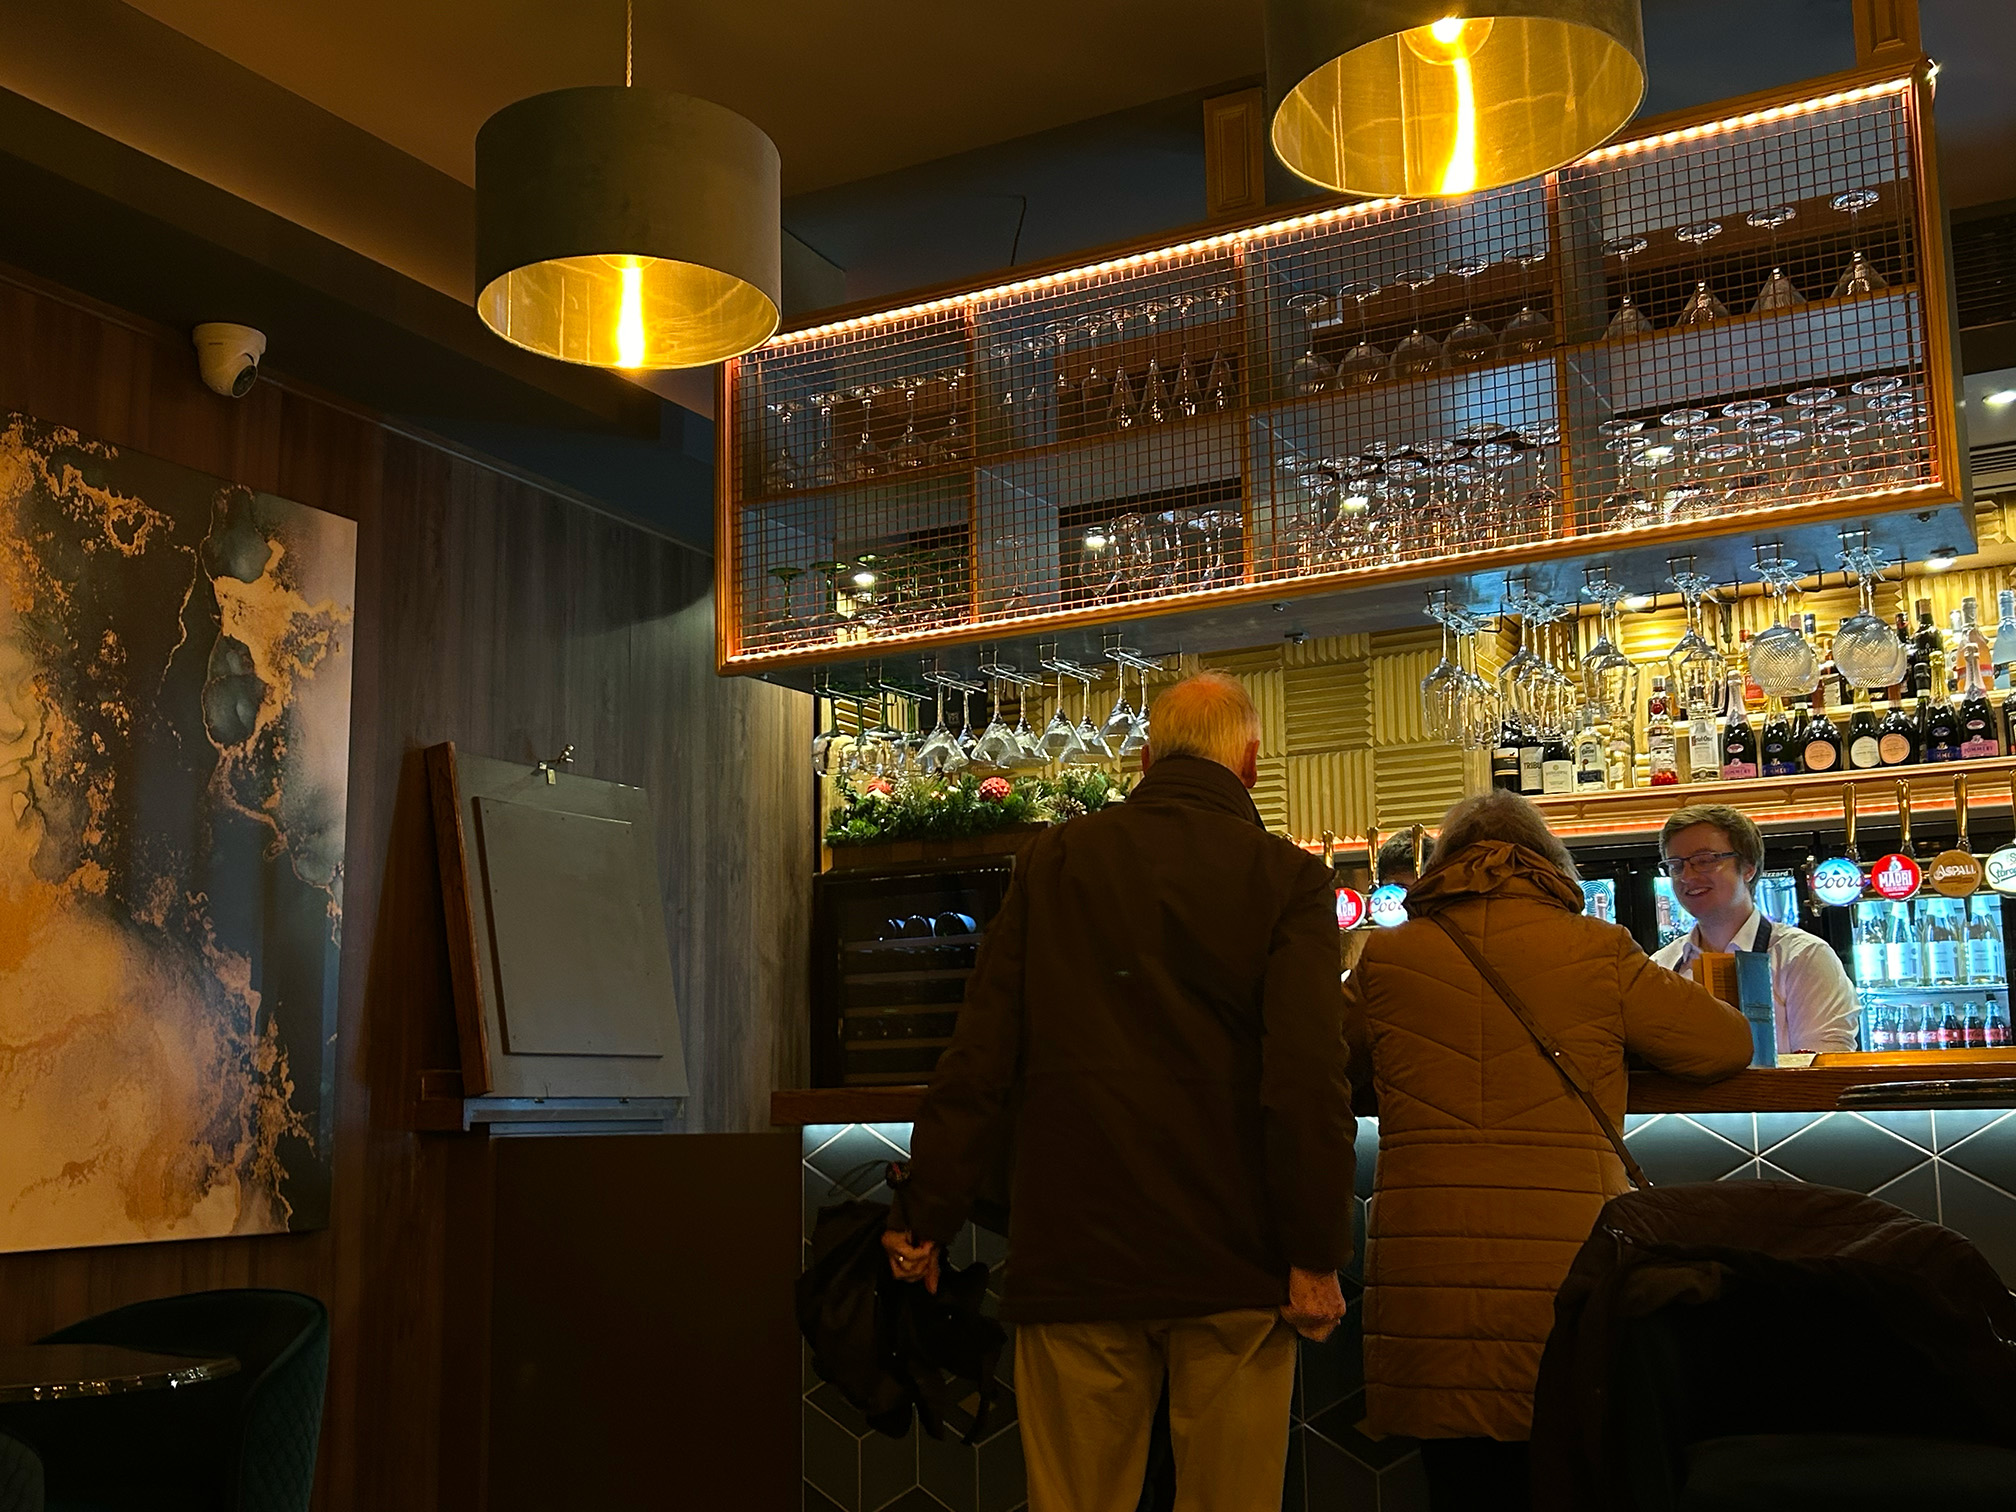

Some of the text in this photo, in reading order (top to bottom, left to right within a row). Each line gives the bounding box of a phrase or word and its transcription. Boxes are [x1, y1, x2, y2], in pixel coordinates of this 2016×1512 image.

[1811, 871, 1866, 890] Coors
[1933, 864, 1977, 880] ASPALL
[1369, 897, 1402, 914] Coo
